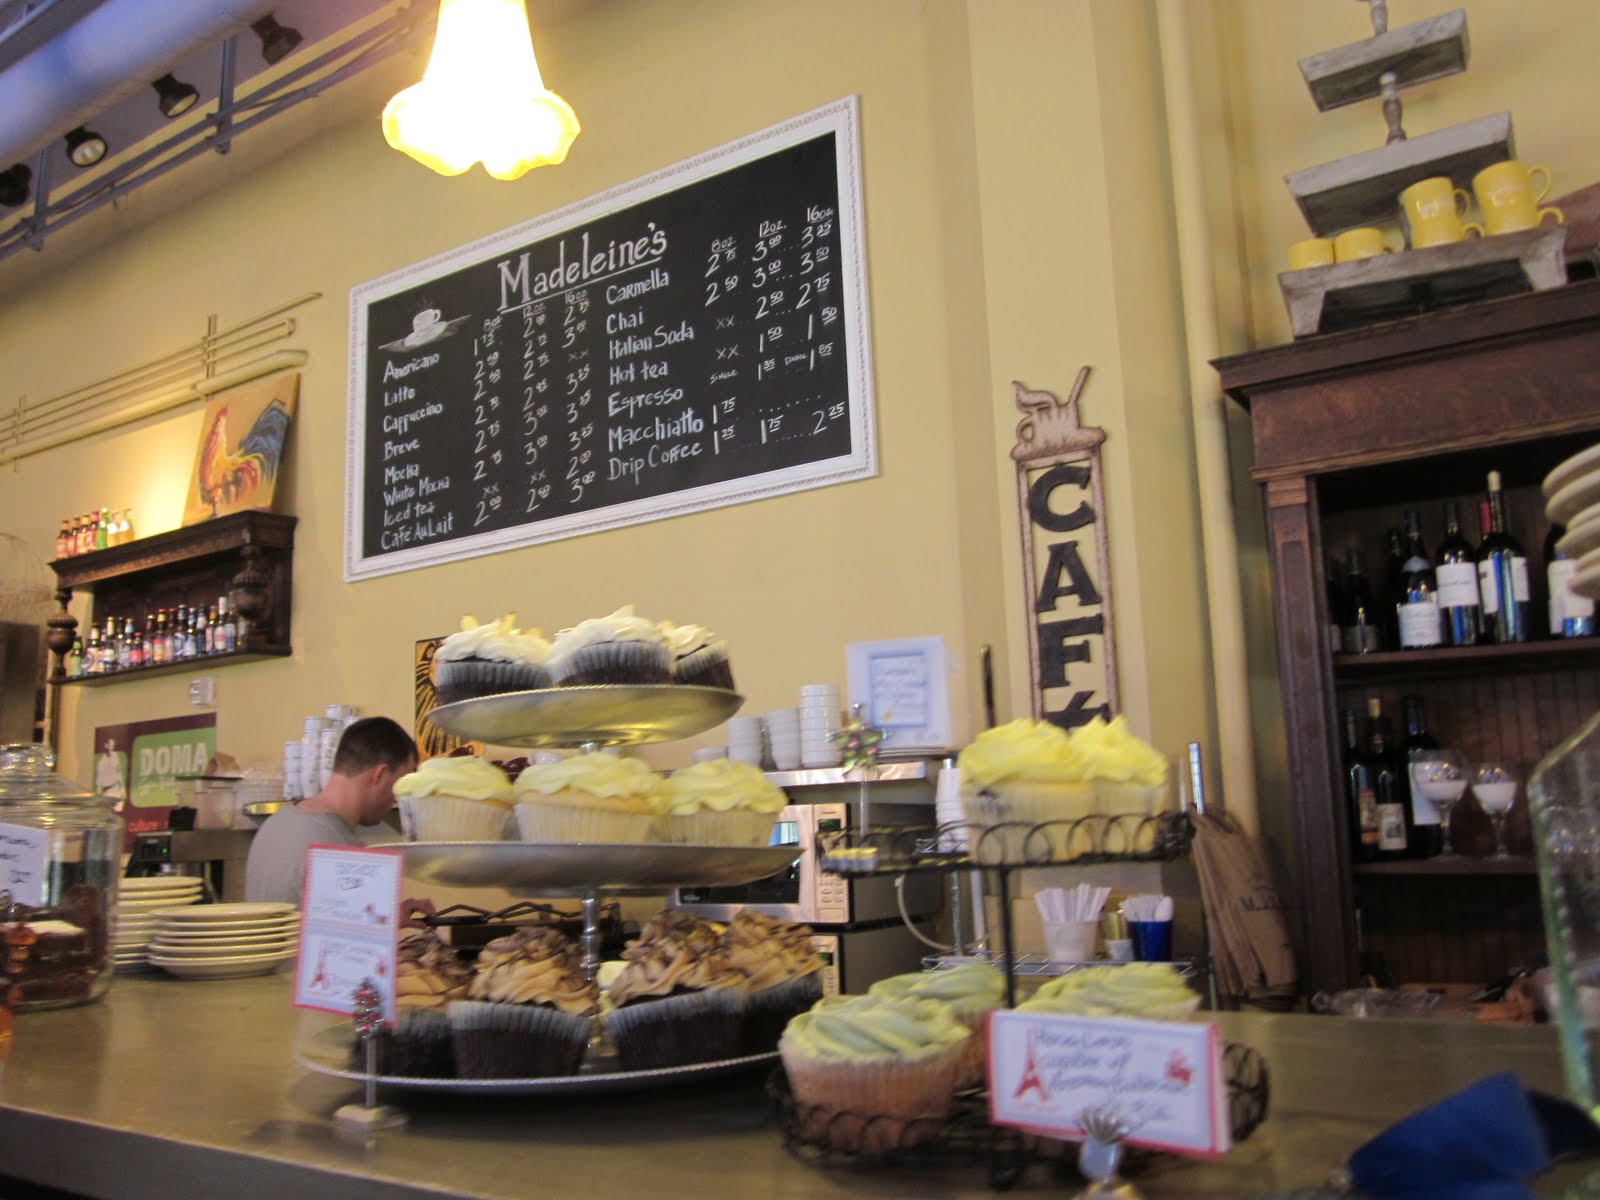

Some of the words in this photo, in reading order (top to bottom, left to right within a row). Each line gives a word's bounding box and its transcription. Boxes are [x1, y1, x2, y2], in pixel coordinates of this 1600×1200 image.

[497, 222, 668, 311] Madeleine's
[606, 306, 643, 334] Chai
[609, 336, 652, 361] Italian
[654, 320, 694, 348] Soda
[383, 353, 440, 383] Americano
[609, 362, 635, 386] Hot
[640, 360, 669, 381] tea
[384, 385, 416, 407] Latte
[608, 387, 684, 419] Espresso
[384, 438, 420, 461] Breve
[606, 457, 645, 486] Drip
[384, 502, 412, 528] Iced
[414, 501, 435, 518] tea
[139, 742, 209, 778] DOMA
